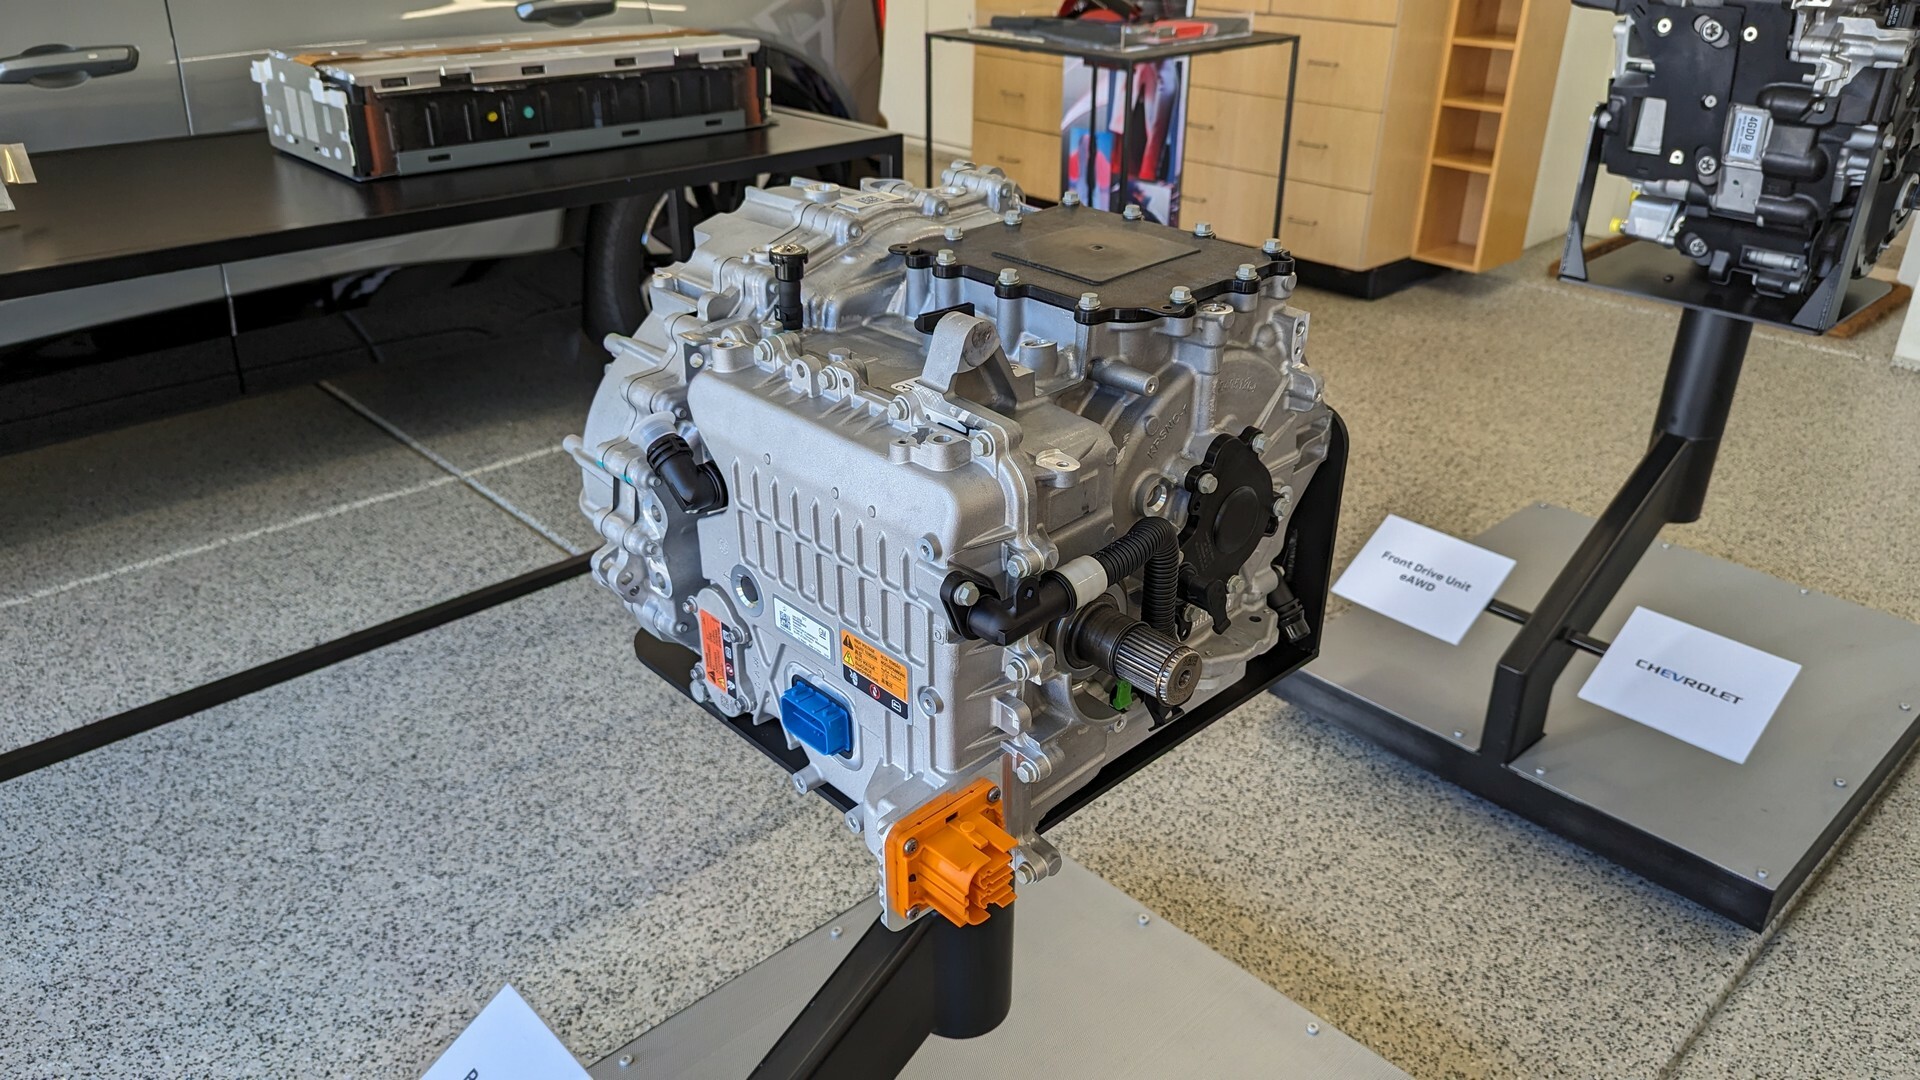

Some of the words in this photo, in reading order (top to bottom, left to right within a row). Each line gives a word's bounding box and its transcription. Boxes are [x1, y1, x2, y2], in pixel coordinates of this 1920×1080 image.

[1745, 116, 1758, 141] 4GDD
[1381, 551, 1413, 569] Front
[1413, 563, 1444, 581] Drive
[1445, 575, 1472, 592] Unit
[1399, 574, 1436, 592] eAWD
[1635, 659, 1743, 705] CHEVROLET
